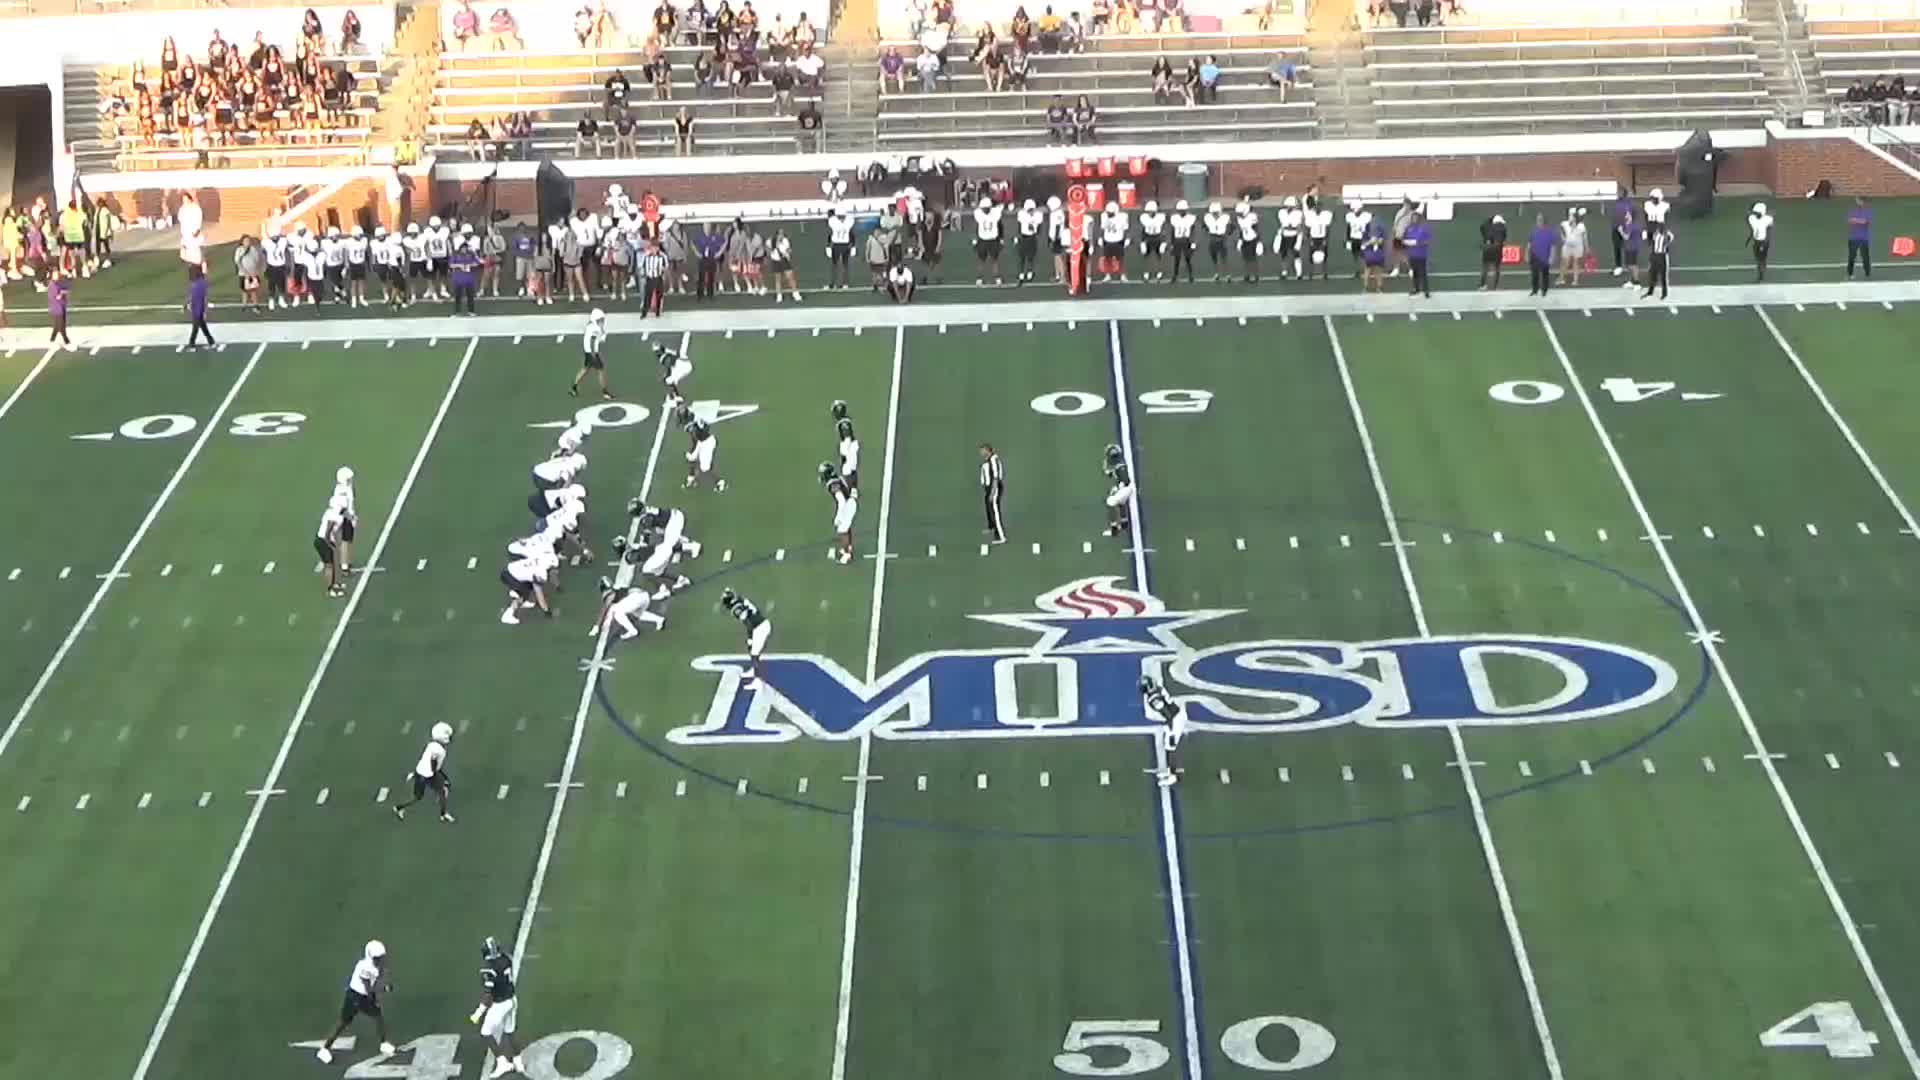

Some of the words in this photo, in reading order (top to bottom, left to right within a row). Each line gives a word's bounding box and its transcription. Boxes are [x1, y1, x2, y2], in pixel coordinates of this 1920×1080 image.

[119, 411, 307, 440] 30
[1031, 389, 1215, 416] 50
[667, 632, 1677, 746] MISD
[343, 1030, 634, 1080] 40
[1054, 1016, 1337, 1077] 50
